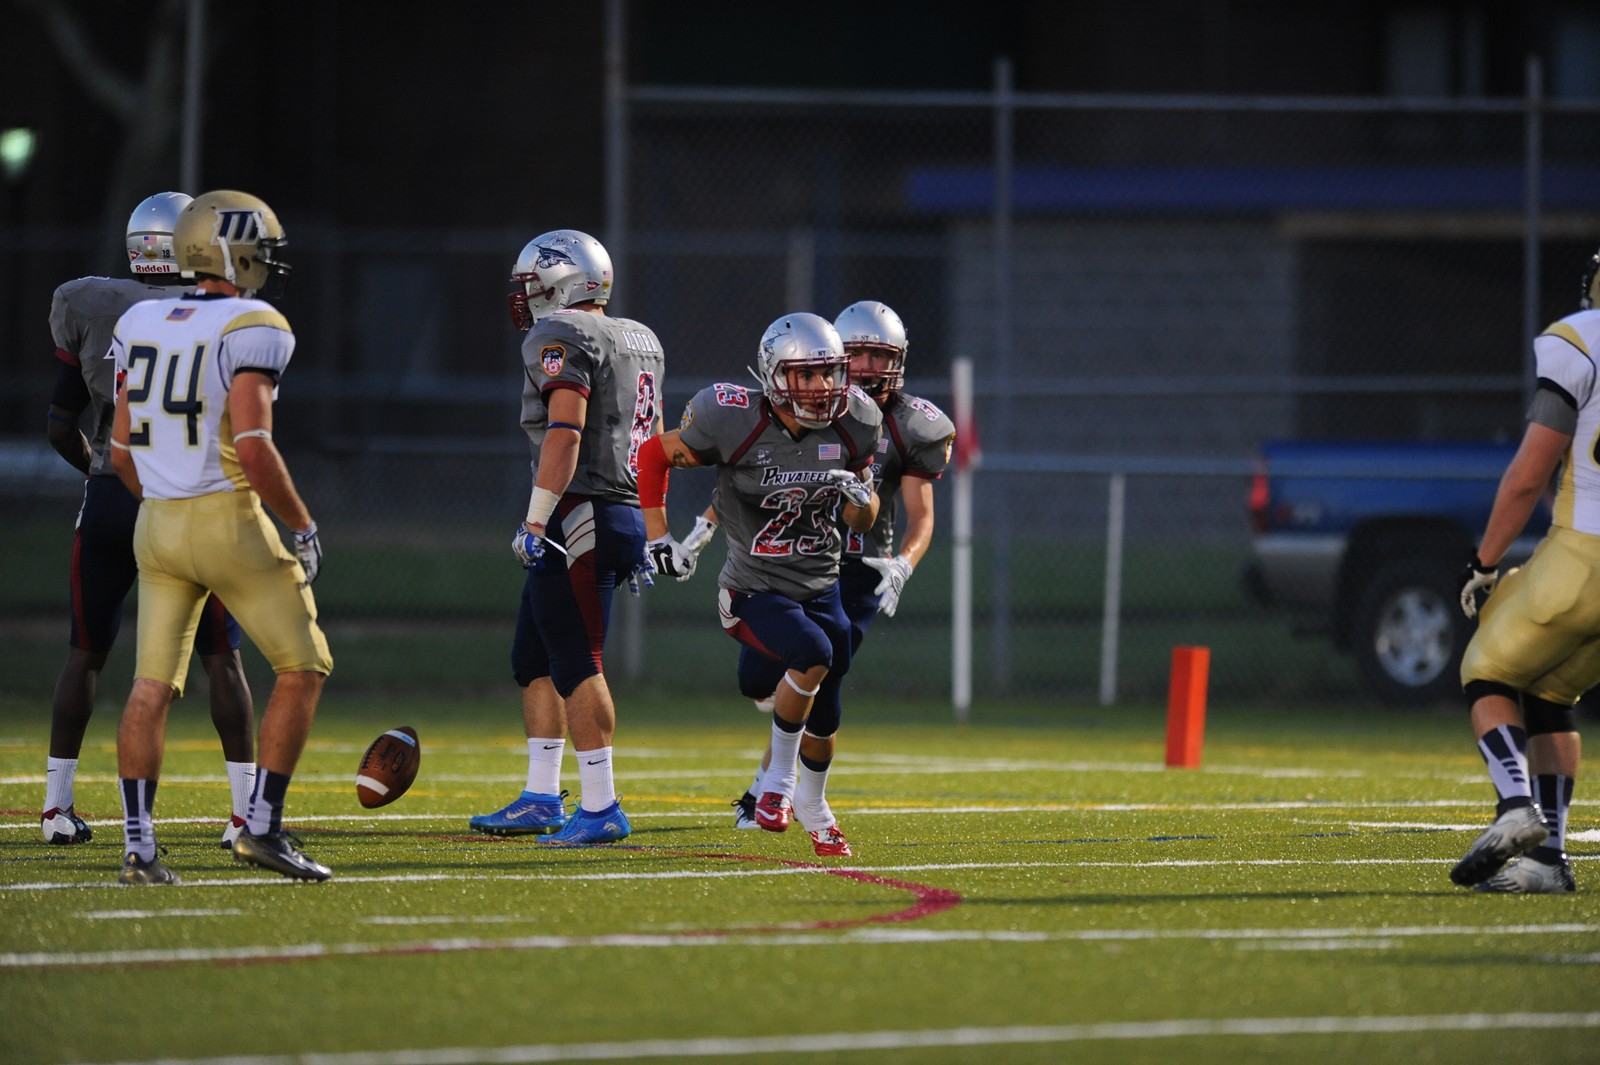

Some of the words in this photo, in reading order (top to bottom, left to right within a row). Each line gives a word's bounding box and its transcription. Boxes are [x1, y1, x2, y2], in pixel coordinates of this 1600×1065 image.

[162, 249, 171, 259] 18
[135, 264, 171, 273] Riddell
[127, 341, 209, 451] 24
[760, 466, 835, 487] PRIVATEE
[750, 484, 841, 557] 23
